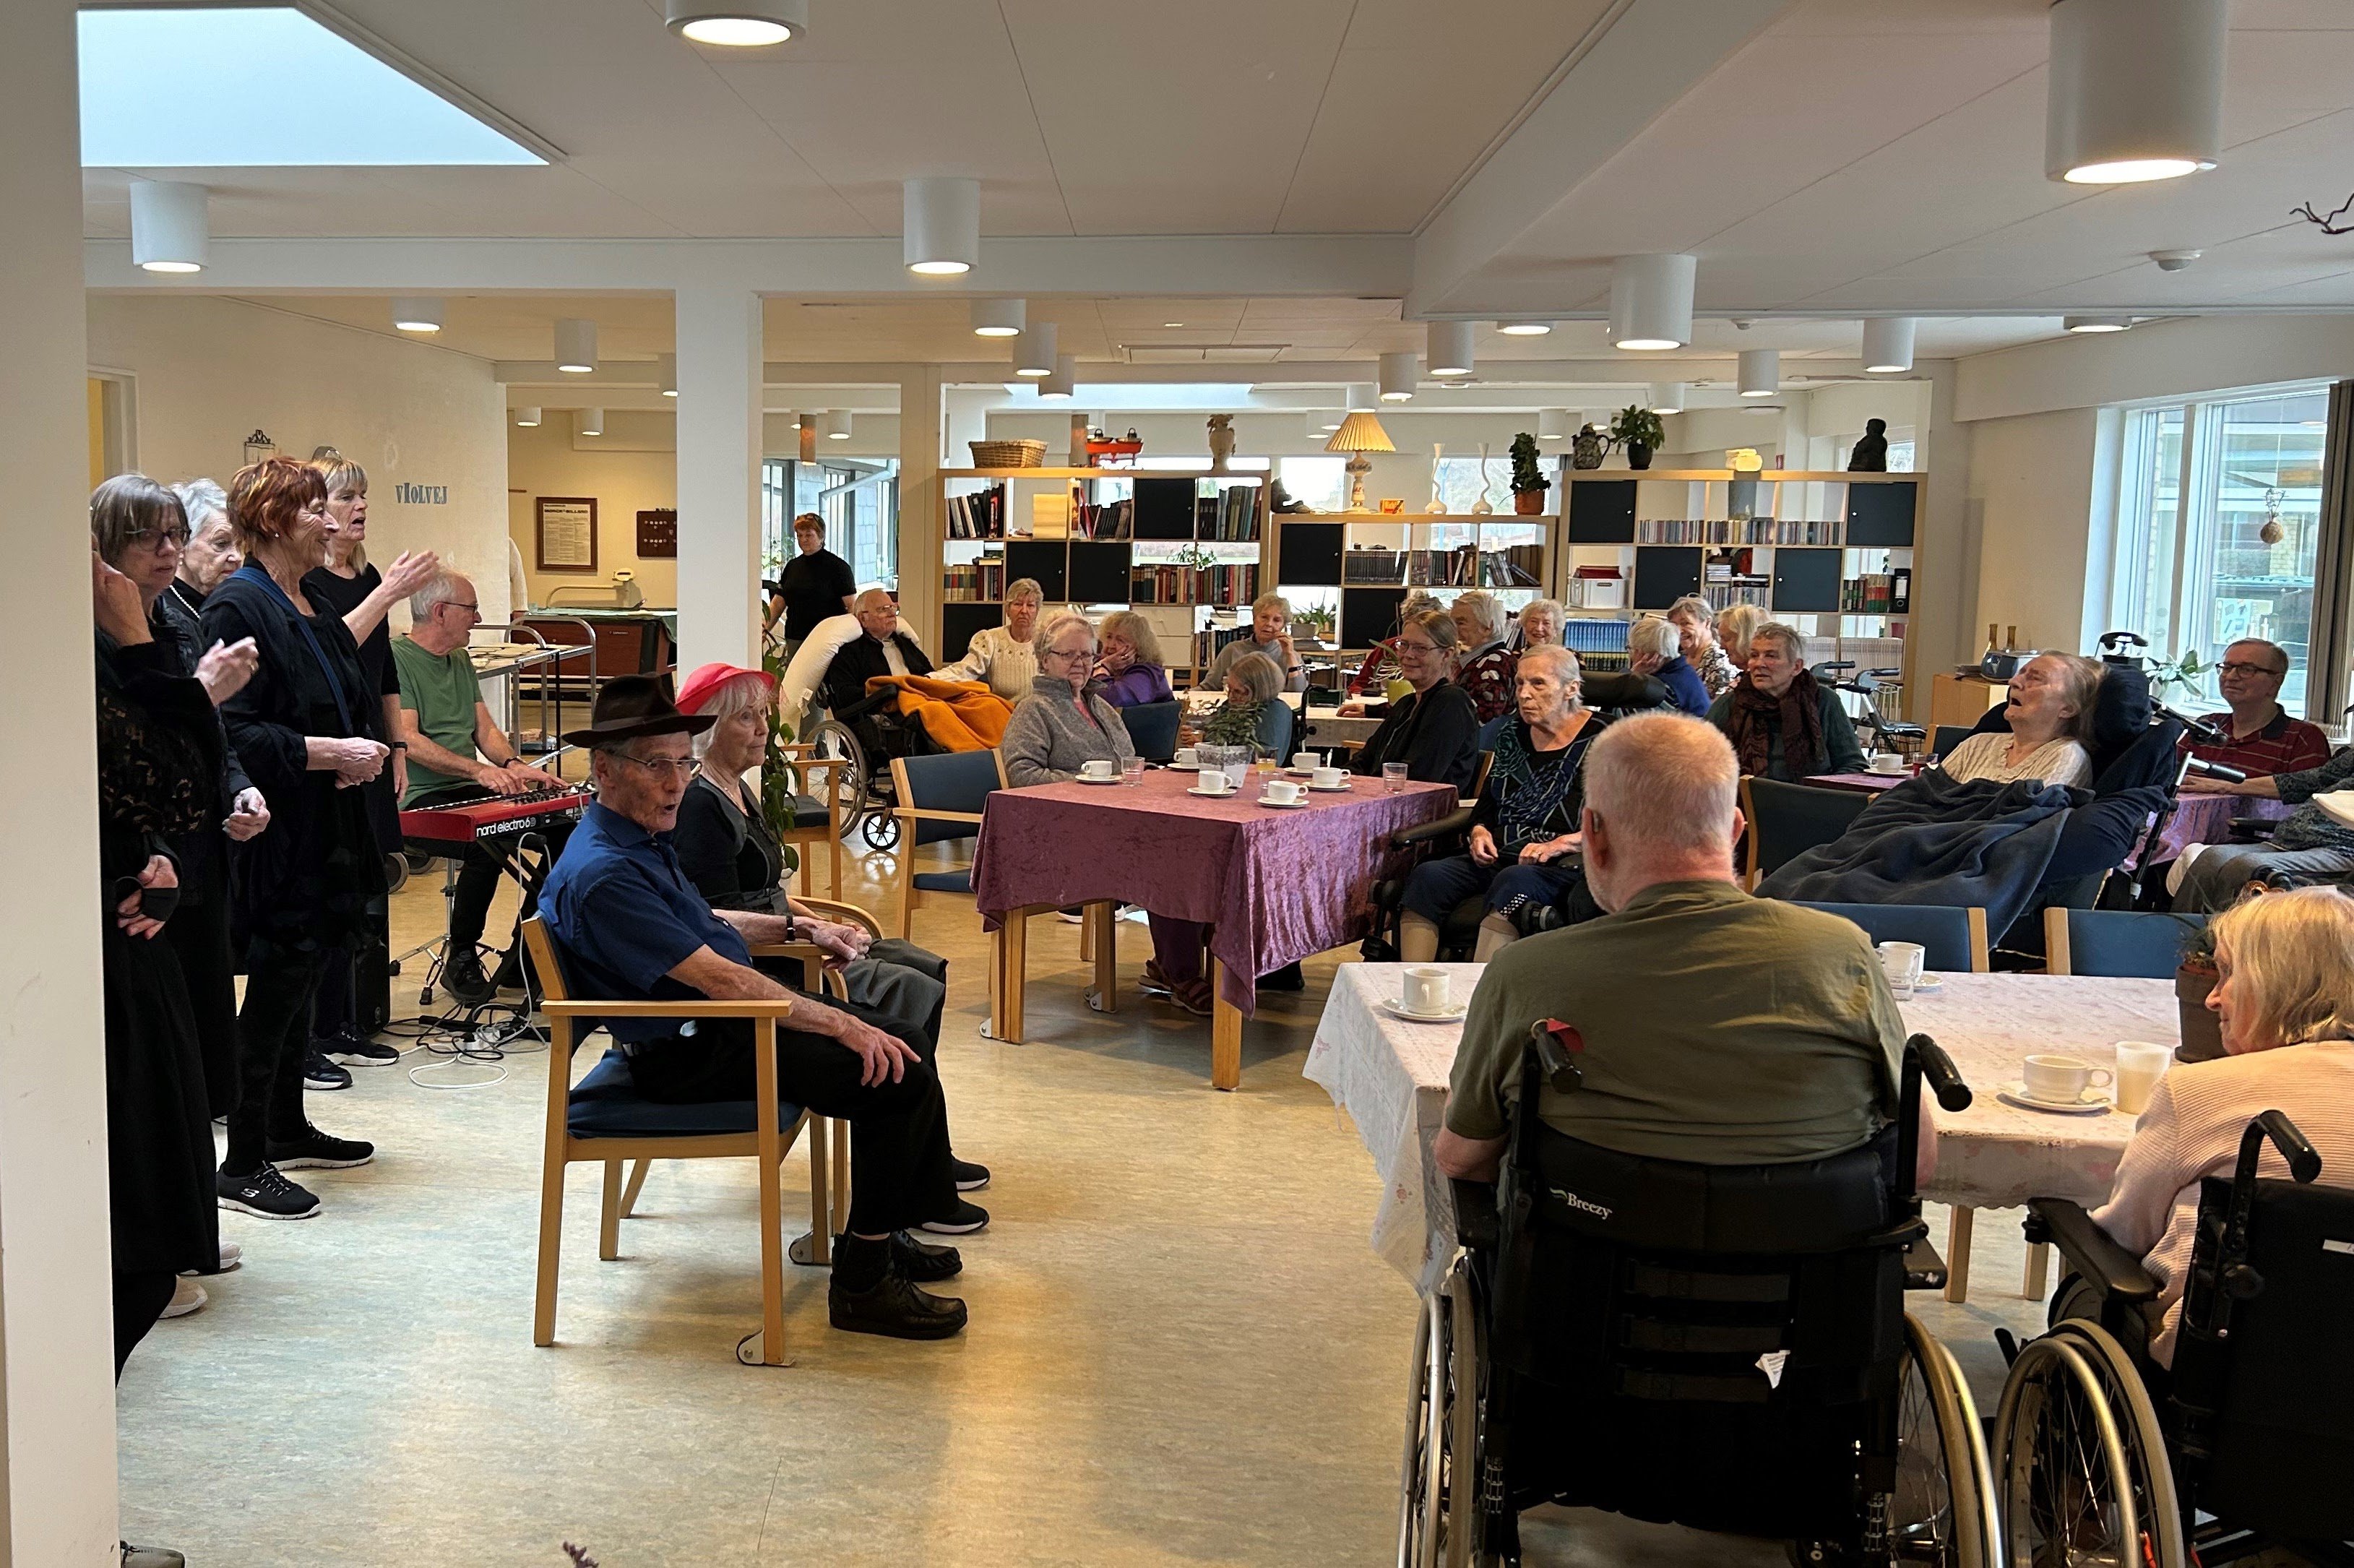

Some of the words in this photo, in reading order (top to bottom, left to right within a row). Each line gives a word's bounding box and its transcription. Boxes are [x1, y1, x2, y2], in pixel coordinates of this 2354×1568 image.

[476, 822, 496, 837] nord
[497, 819, 525, 833] electro
[1567, 1192, 1613, 1220] Breezy
